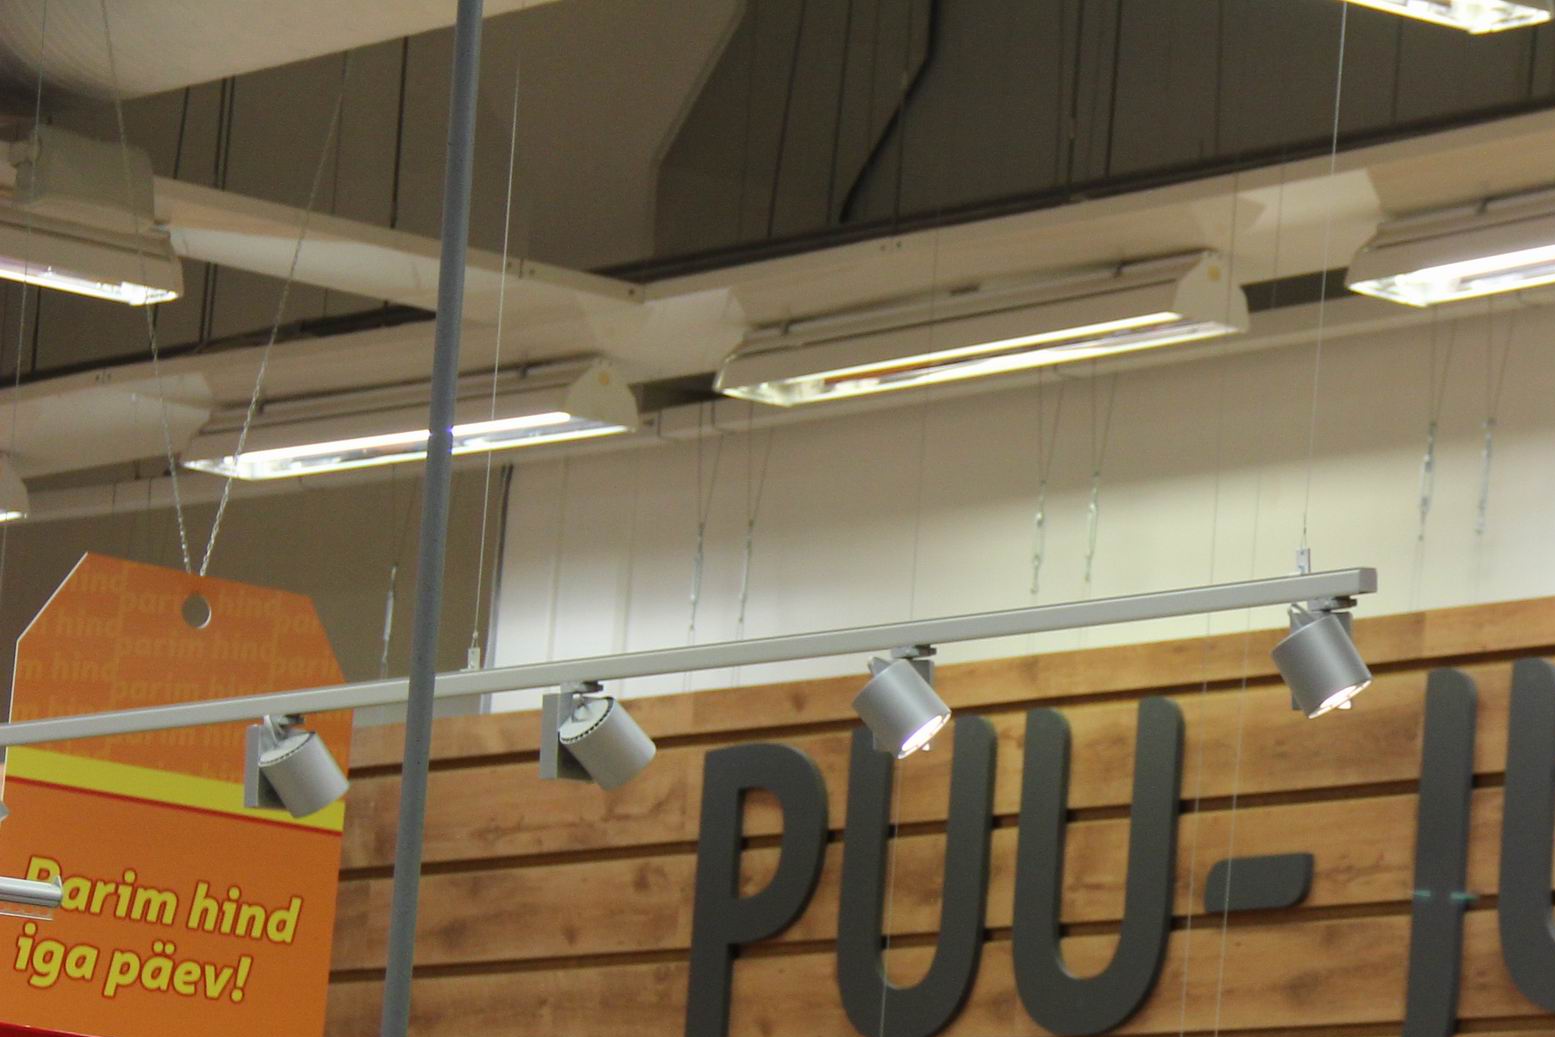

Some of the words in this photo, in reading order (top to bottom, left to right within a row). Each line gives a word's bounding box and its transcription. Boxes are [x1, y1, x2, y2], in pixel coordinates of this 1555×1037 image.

[25, 855, 178, 925] Parim
[187, 879, 302, 944] hind
[14, 922, 98, 988] iga
[102, 940, 253, 1003] päev!
